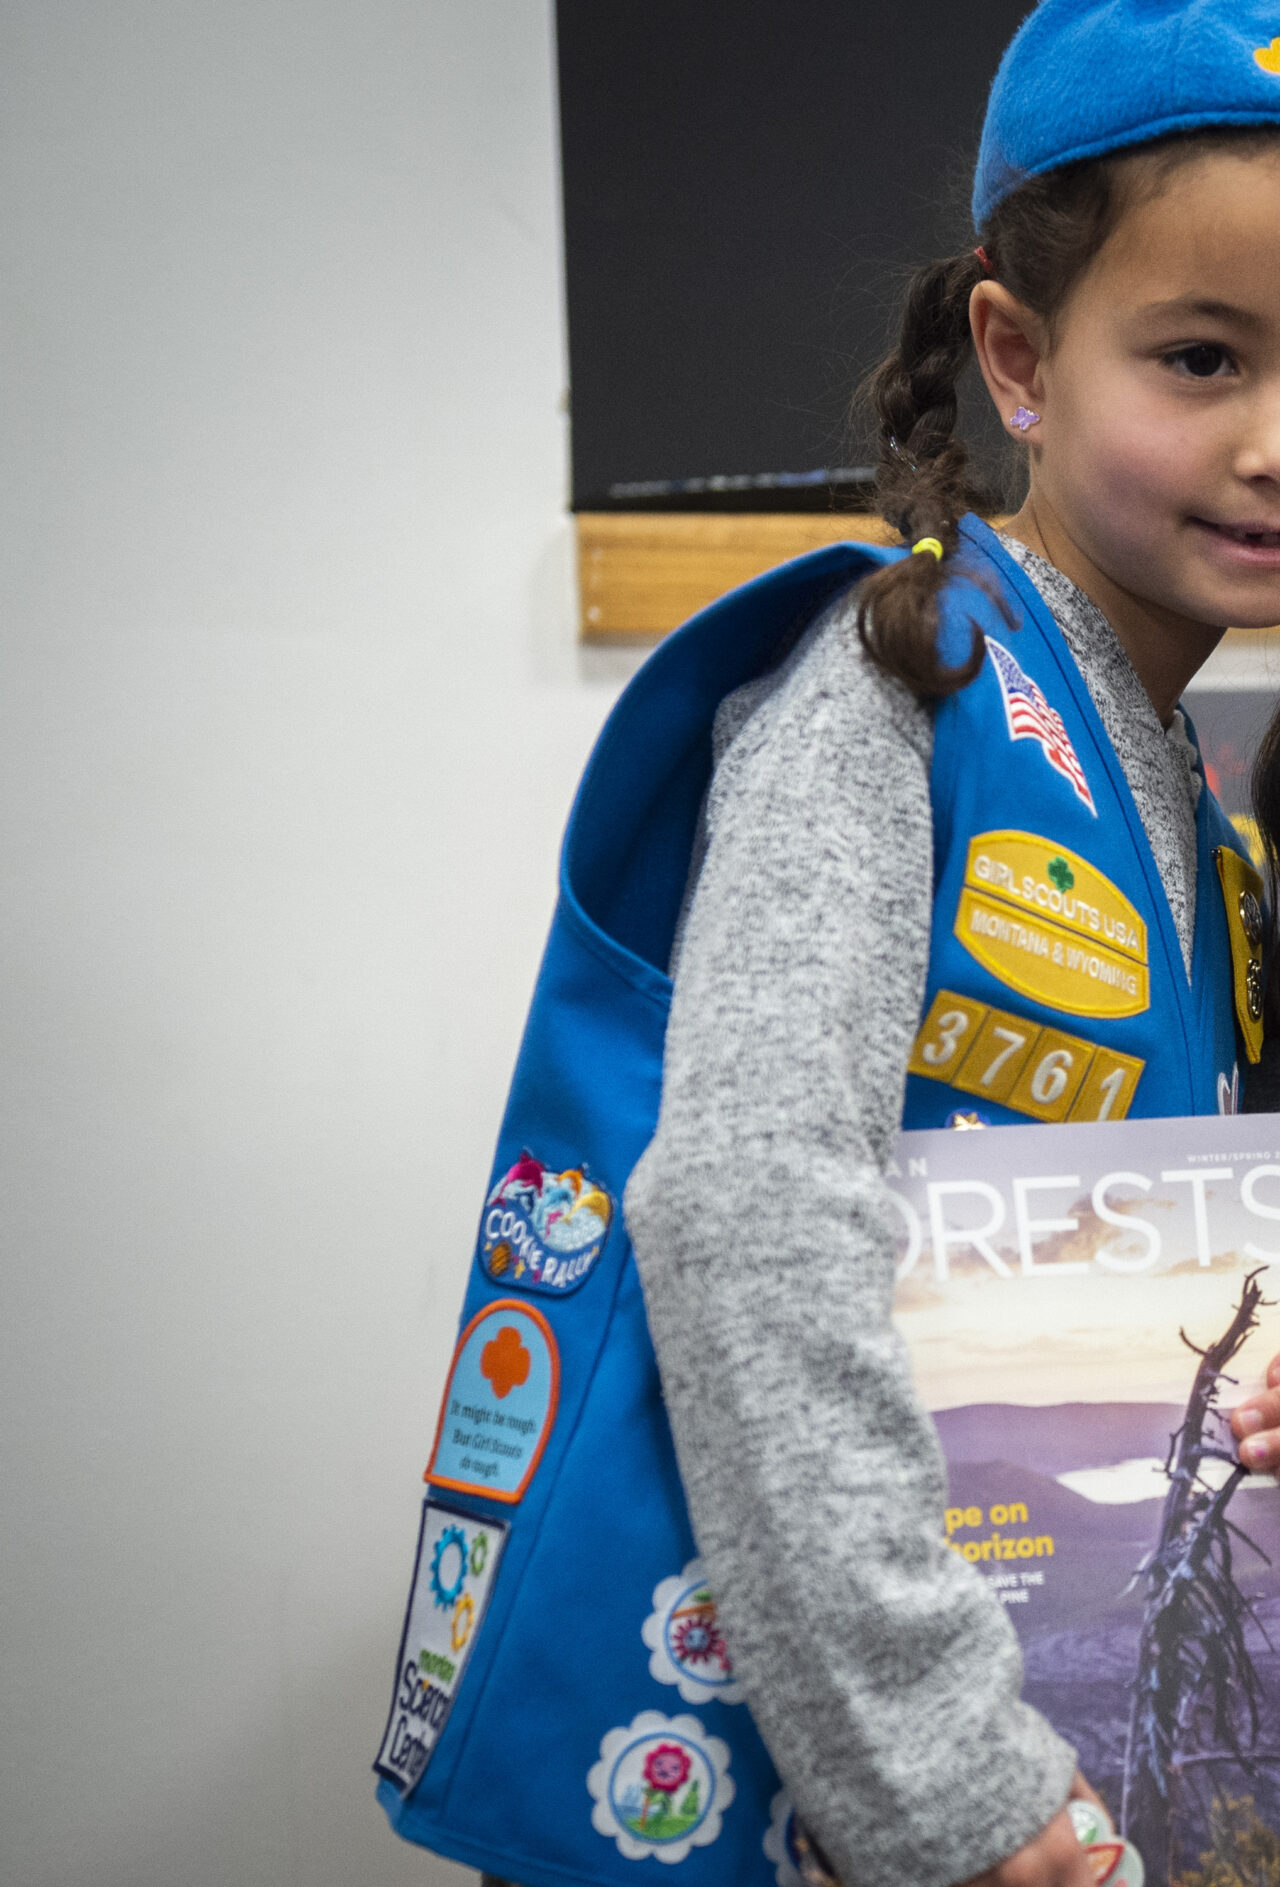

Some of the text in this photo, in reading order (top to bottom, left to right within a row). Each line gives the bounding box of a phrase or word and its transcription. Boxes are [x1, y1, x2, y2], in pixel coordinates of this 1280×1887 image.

[973, 855, 1140, 952] GIRL SCOUTS USA
[970, 909, 1137, 995] MONTANA & WYOMING
[486, 1208, 543, 1270] COOKIE
[989, 1502, 1029, 1526] on
